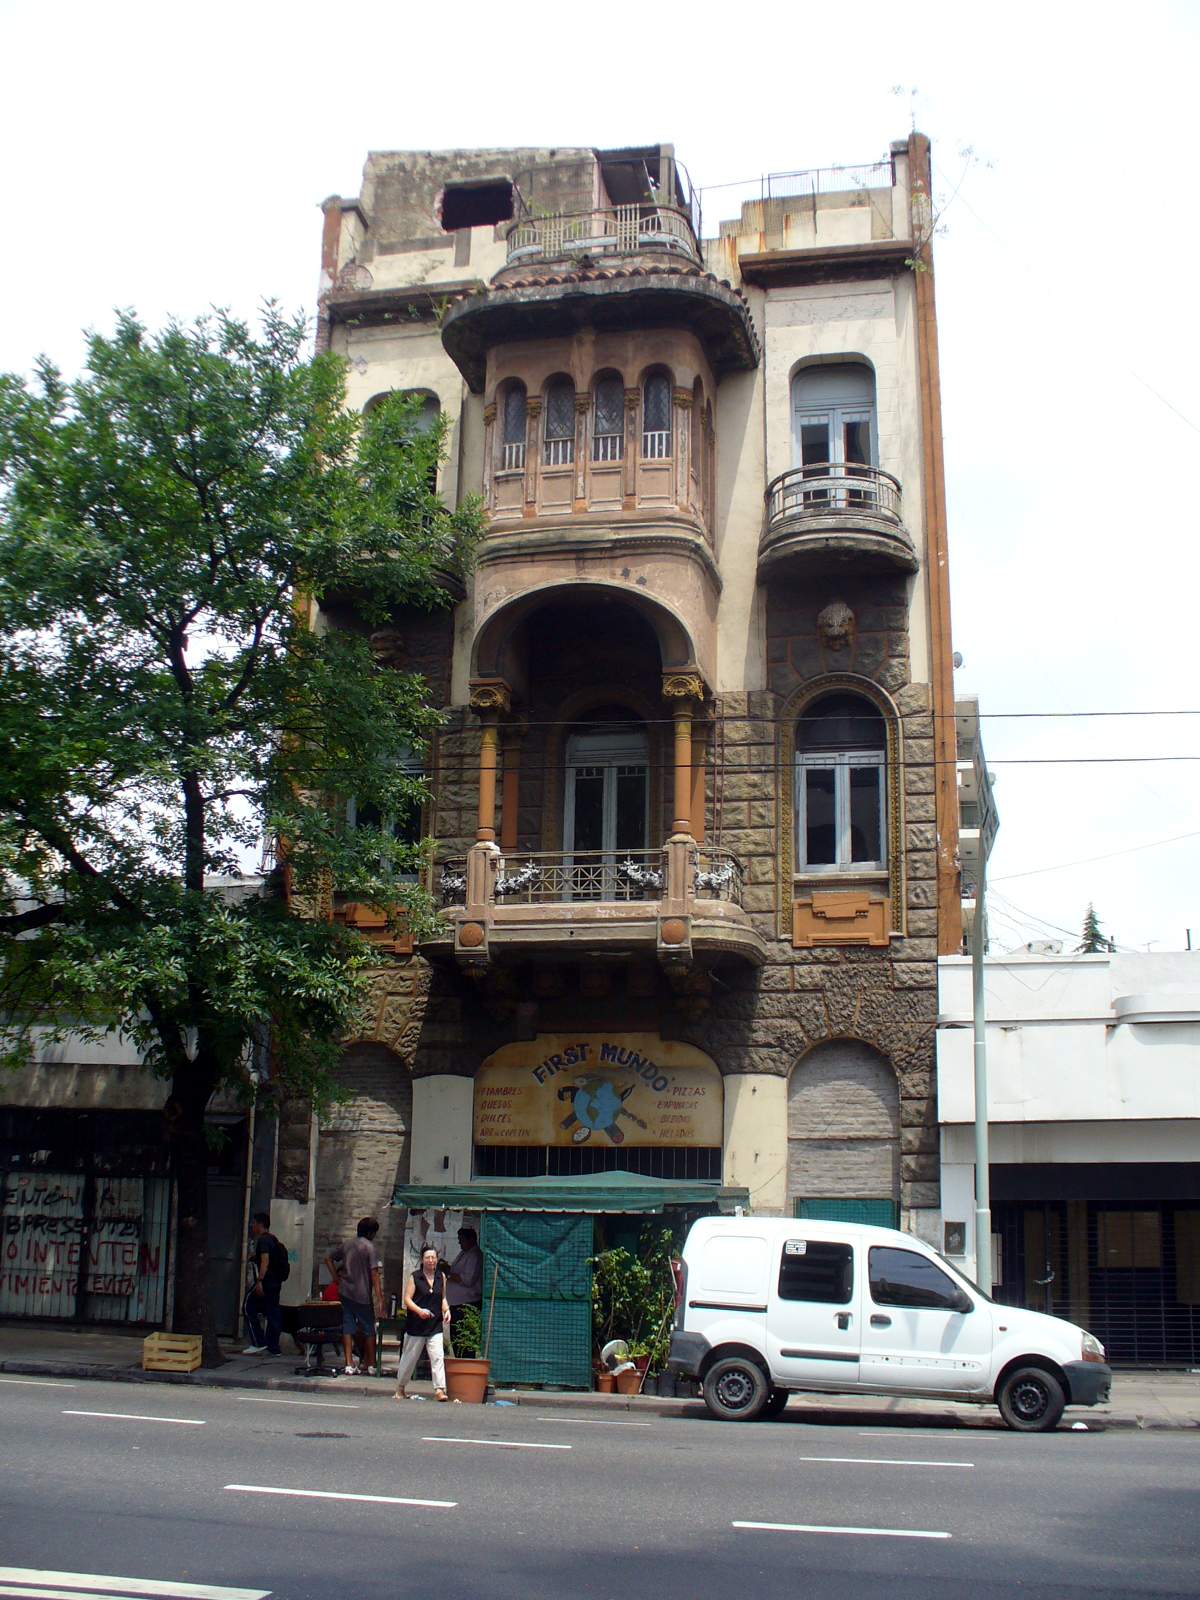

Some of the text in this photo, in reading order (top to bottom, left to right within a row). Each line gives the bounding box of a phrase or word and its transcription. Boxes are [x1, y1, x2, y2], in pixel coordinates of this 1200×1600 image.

[531, 1042, 669, 1092] FIRST MUNDO
[672, 1087, 706, 1096] PIZZAS
[480, 1100, 513, 1110] QUESOS
[480, 1113, 512, 1123] DULCES
